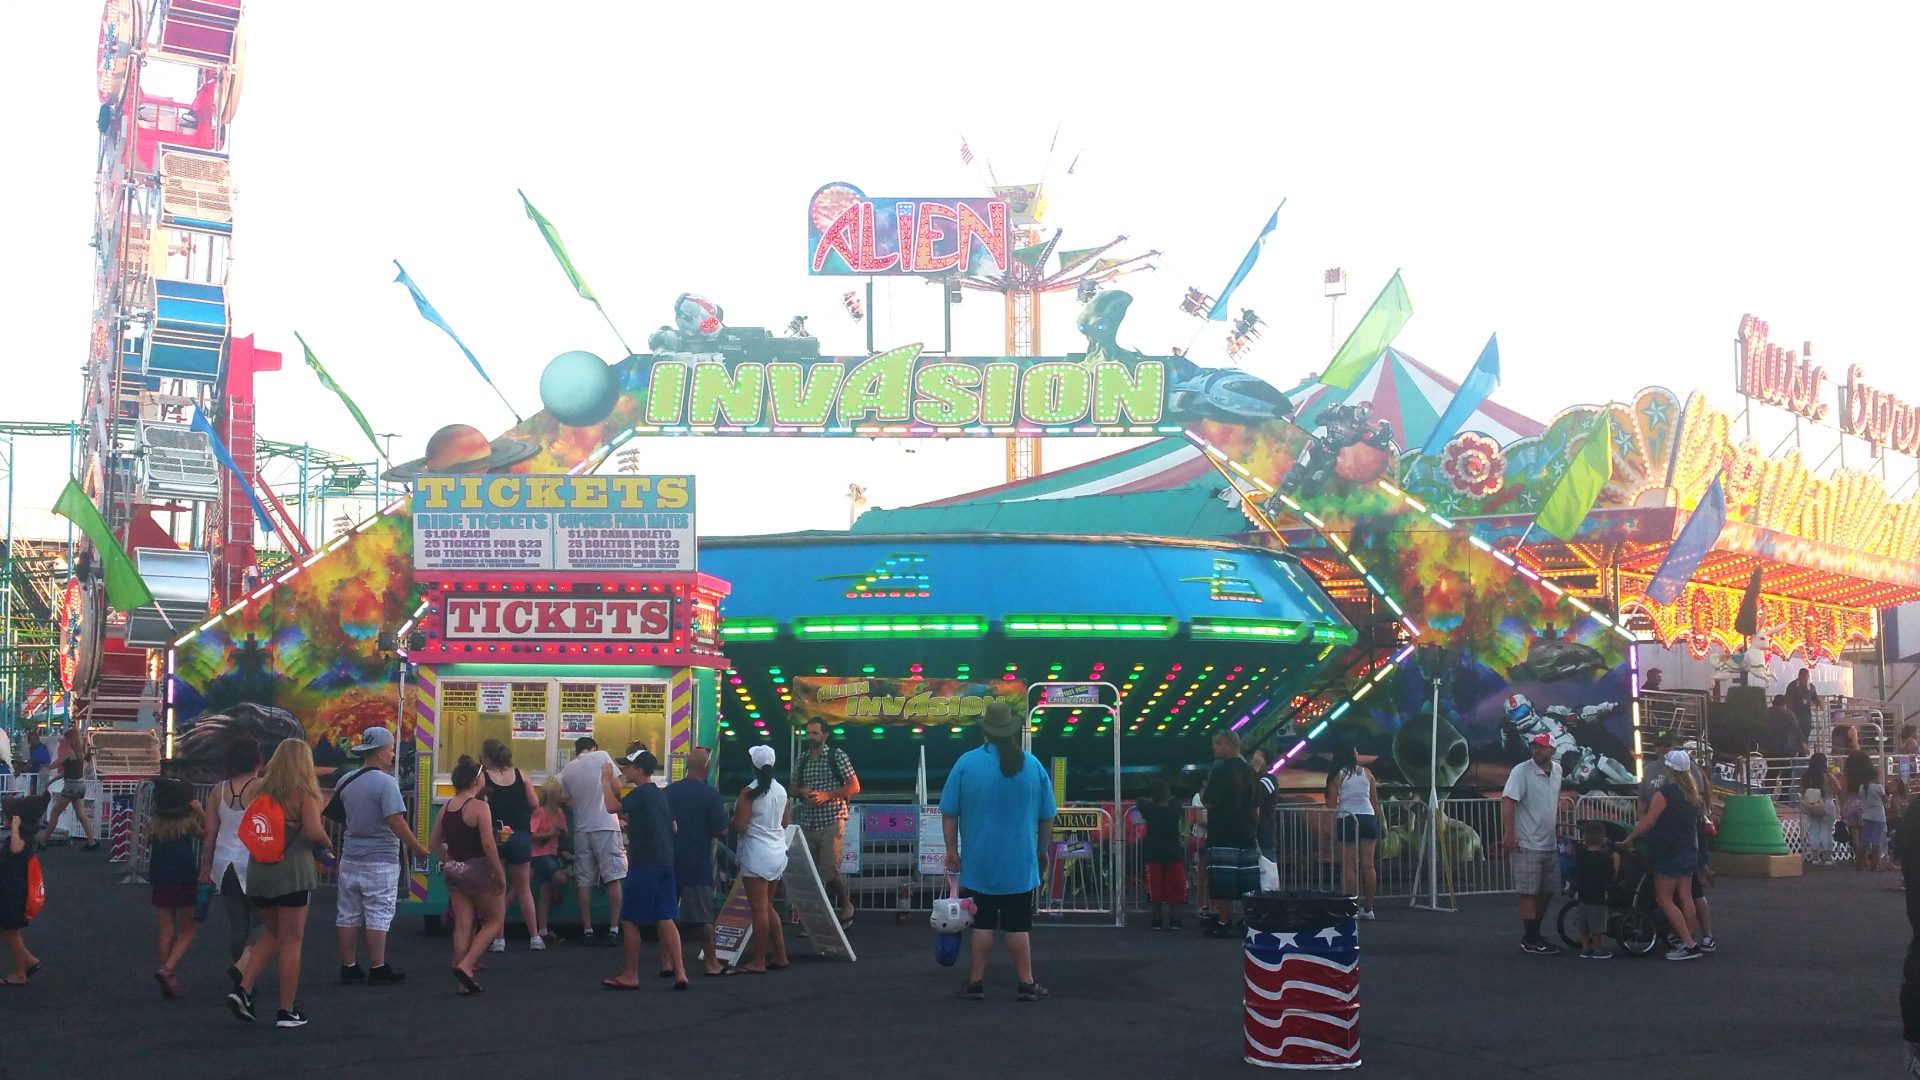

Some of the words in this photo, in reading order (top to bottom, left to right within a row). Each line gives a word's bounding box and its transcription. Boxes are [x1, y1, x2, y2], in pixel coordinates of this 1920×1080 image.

[812, 201, 1008, 272] ALIEN
[646, 342, 1165, 427] INVASION
[417, 477, 689, 509] TICKETS
[417, 514, 463, 529] RIDE
[466, 514, 548, 529] TICKETS
[424, 530, 457, 538] $1.00
[460, 530, 490, 538] EACH
[568, 530, 598, 538] $1.00
[600, 530, 629, 538] CADA
[632, 530, 671, 538] BOLETO
[424, 540, 440, 548] 25
[442, 540, 491, 548] TICKETS
[493, 540, 516, 548] FOR
[518, 540, 542, 548] $23
[568, 540, 582, 548] 25
[584, 540, 631, 548] BOLETOS
[634, 540, 656, 548] POR
[658, 540, 680, 548] $23
[424, 549, 440, 558] 80
[443, 549, 491, 558] TICKETS
[494, 549, 516, 558] FOR
[519, 549, 541, 558] $70
[585, 549, 631, 558] BOLETOS
[634, 549, 656, 558] POR
[658, 549, 679, 558] $70
[448, 600, 669, 634] TICKETS
[817, 681, 870, 703] ALIEN
[888, 818, 897, 828] 5
[1055, 814, 1096, 826] NTRANCE
